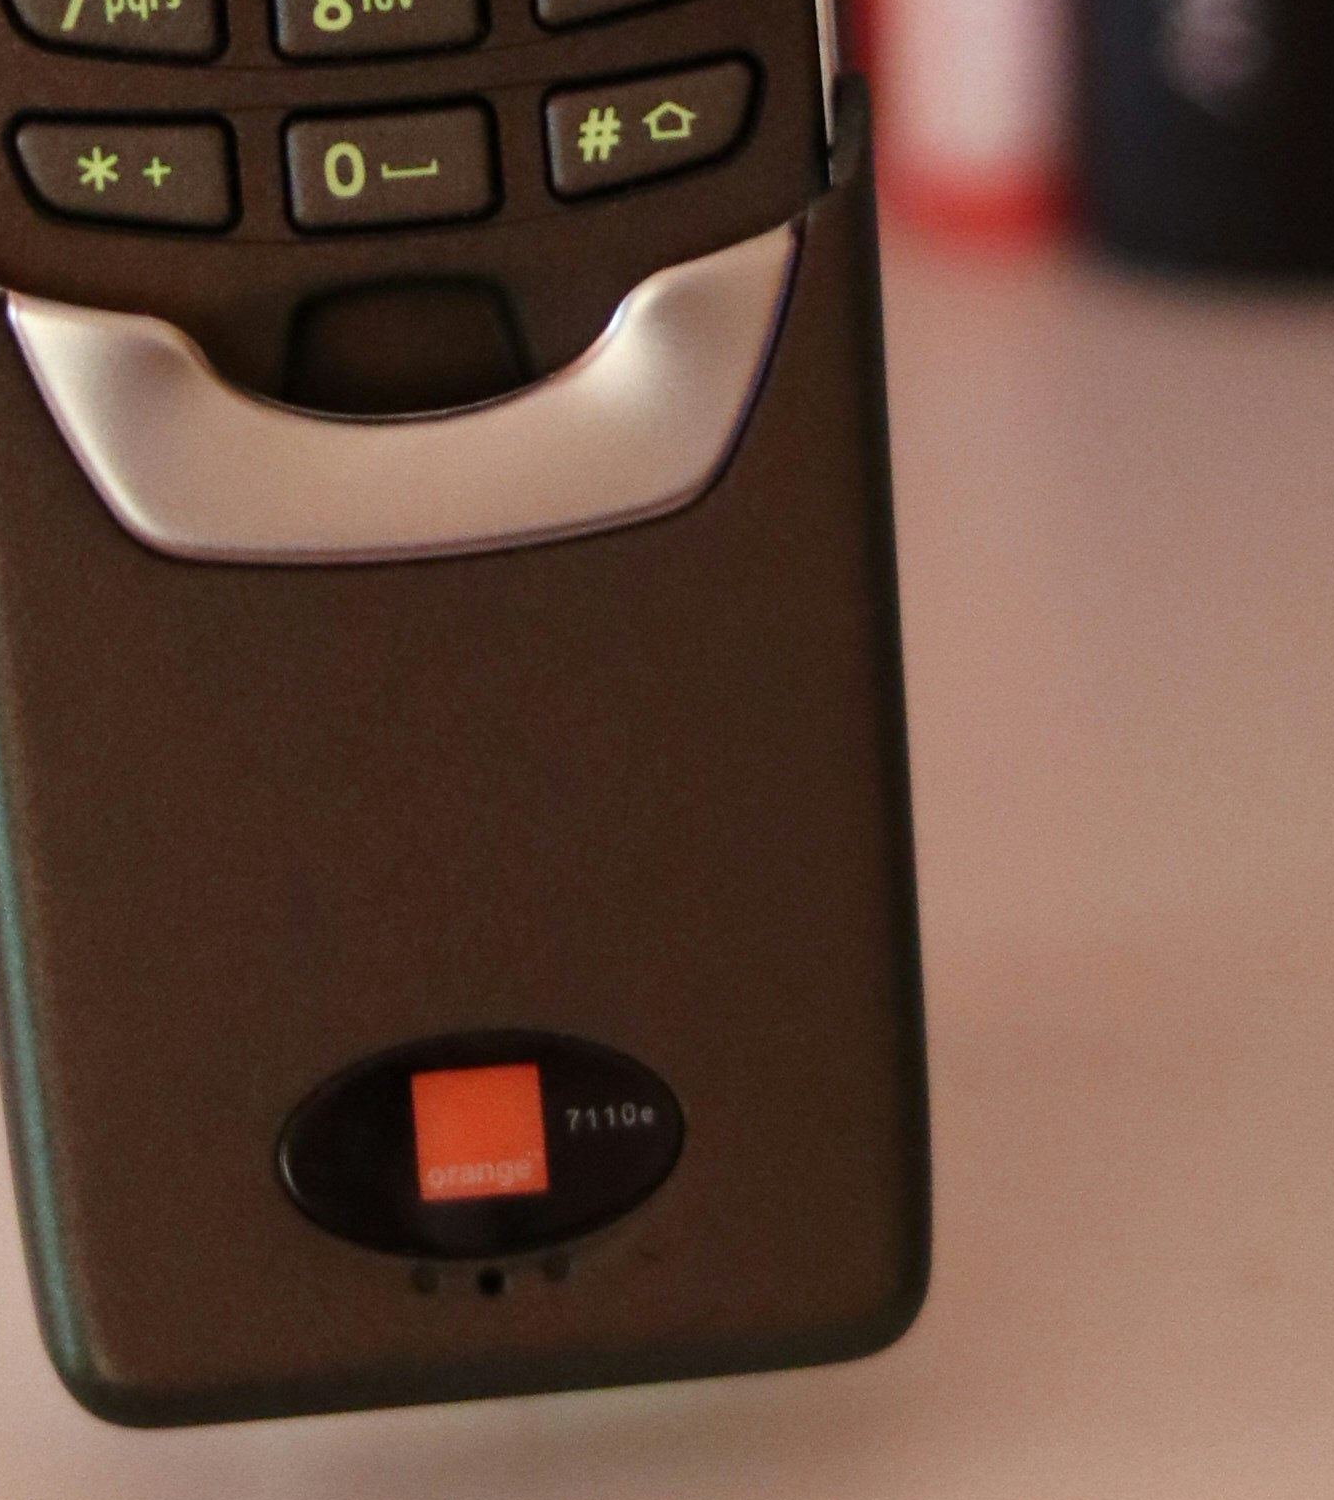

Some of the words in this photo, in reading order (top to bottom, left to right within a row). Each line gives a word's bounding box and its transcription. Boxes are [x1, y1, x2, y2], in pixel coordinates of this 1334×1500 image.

[577, 106, 622, 164] #
[323, 141, 367, 200] 0
[566, 1101, 655, 1132] 7110e
[426, 1158, 533, 1192] orange
